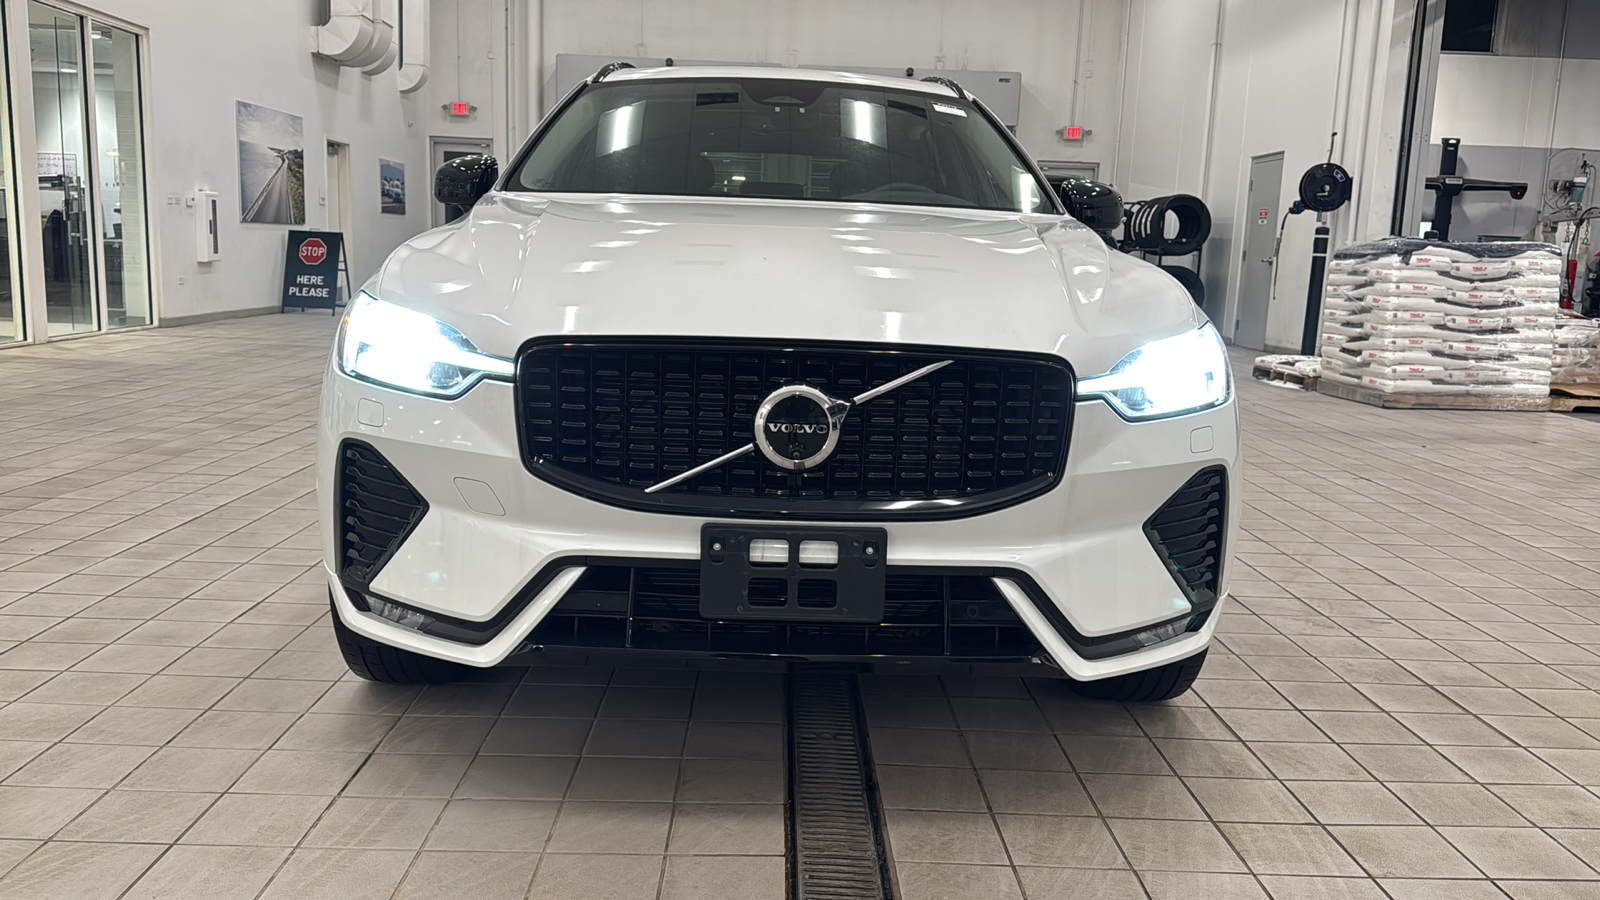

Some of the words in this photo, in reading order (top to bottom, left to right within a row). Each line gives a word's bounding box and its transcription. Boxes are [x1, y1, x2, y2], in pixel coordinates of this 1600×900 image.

[301, 246, 325, 257] STOP
[296, 275, 324, 285] HERE
[288, 286, 330, 297] PLEASE
[767, 423, 828, 434] VOLVO
